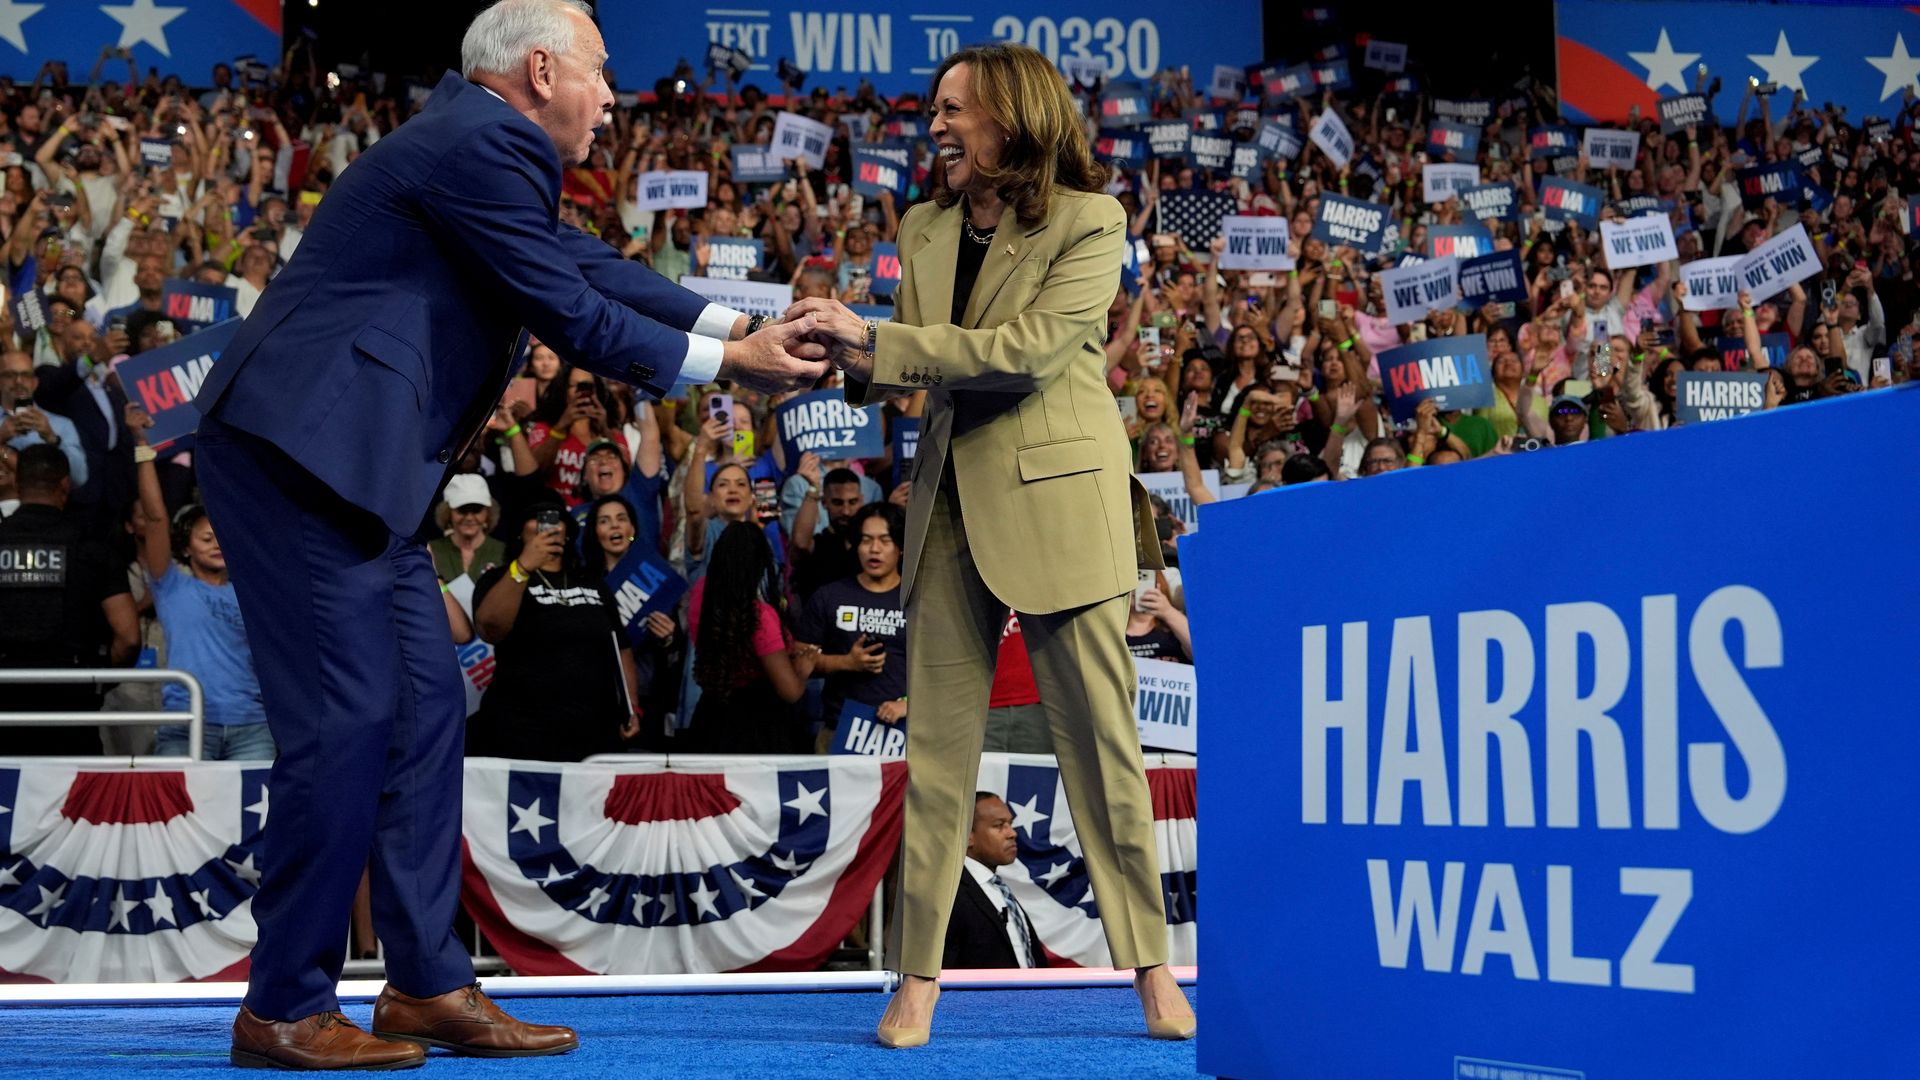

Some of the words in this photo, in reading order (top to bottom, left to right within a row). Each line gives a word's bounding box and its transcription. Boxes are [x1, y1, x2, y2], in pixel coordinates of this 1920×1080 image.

[706, 22, 770, 58] TEXT
[790, 12, 892, 74] WIN
[925, 27, 960, 62] TO
[1661, 96, 1707, 119] HARRIS
[1590, 143, 1607, 158] WE
[1610, 145, 1633, 159] WIN
[646, 185, 665, 200] WE
[670, 184, 699, 196] WIN
[1743, 170, 1798, 197] KAMALA
[1543, 187, 1597, 216] KAMALA
[1322, 200, 1383, 233] HARRIS
[1229, 235, 1253, 255] WE
[1256, 236, 1287, 255] WIN
[1329, 223, 1369, 244] WALZ
[1611, 237, 1634, 255] WE
[1634, 231, 1667, 251] WIN
[708, 243, 757, 268] ARRIS
[1433, 235, 1494, 258] KAMALA
[706, 266, 749, 280] WALZ
[1745, 262, 1772, 289] WE
[1769, 244, 1808, 275] WIN
[1393, 284, 1422, 309] WE
[1423, 274, 1452, 302] WIN
[1461, 273, 1486, 298] WE
[1484, 267, 1518, 293] WIN
[1690, 277, 1714, 297] WE
[1717, 274, 1739, 294] WI
[167, 293, 230, 322] KAMALA
[730, 295, 746, 304] WE
[750, 296, 776, 307] VOTE
[1389, 353, 1484, 399] KAMALA
[1686, 380, 1763, 407] HARRIS
[783, 398, 869, 441] HARRIS
[796, 428, 857, 453] WALZ
[0, 549, 62, 570] OLICE
[614, 561, 668, 627] MALA
[859, 613, 907, 628] EQUALIT
[860, 606, 865, 615] I
[866, 608, 886, 618] AM
[886, 609, 904, 619] AN
[859, 622, 897, 636] VOTER
[1139, 674, 1157, 687] WE
[1160, 678, 1191, 692] VOTE
[1139, 688, 1191, 727] WIN
[1302, 584, 1788, 834] HARRIS
[844, 716, 907, 758] HAR
[1366, 858, 1696, 994] WALZ
